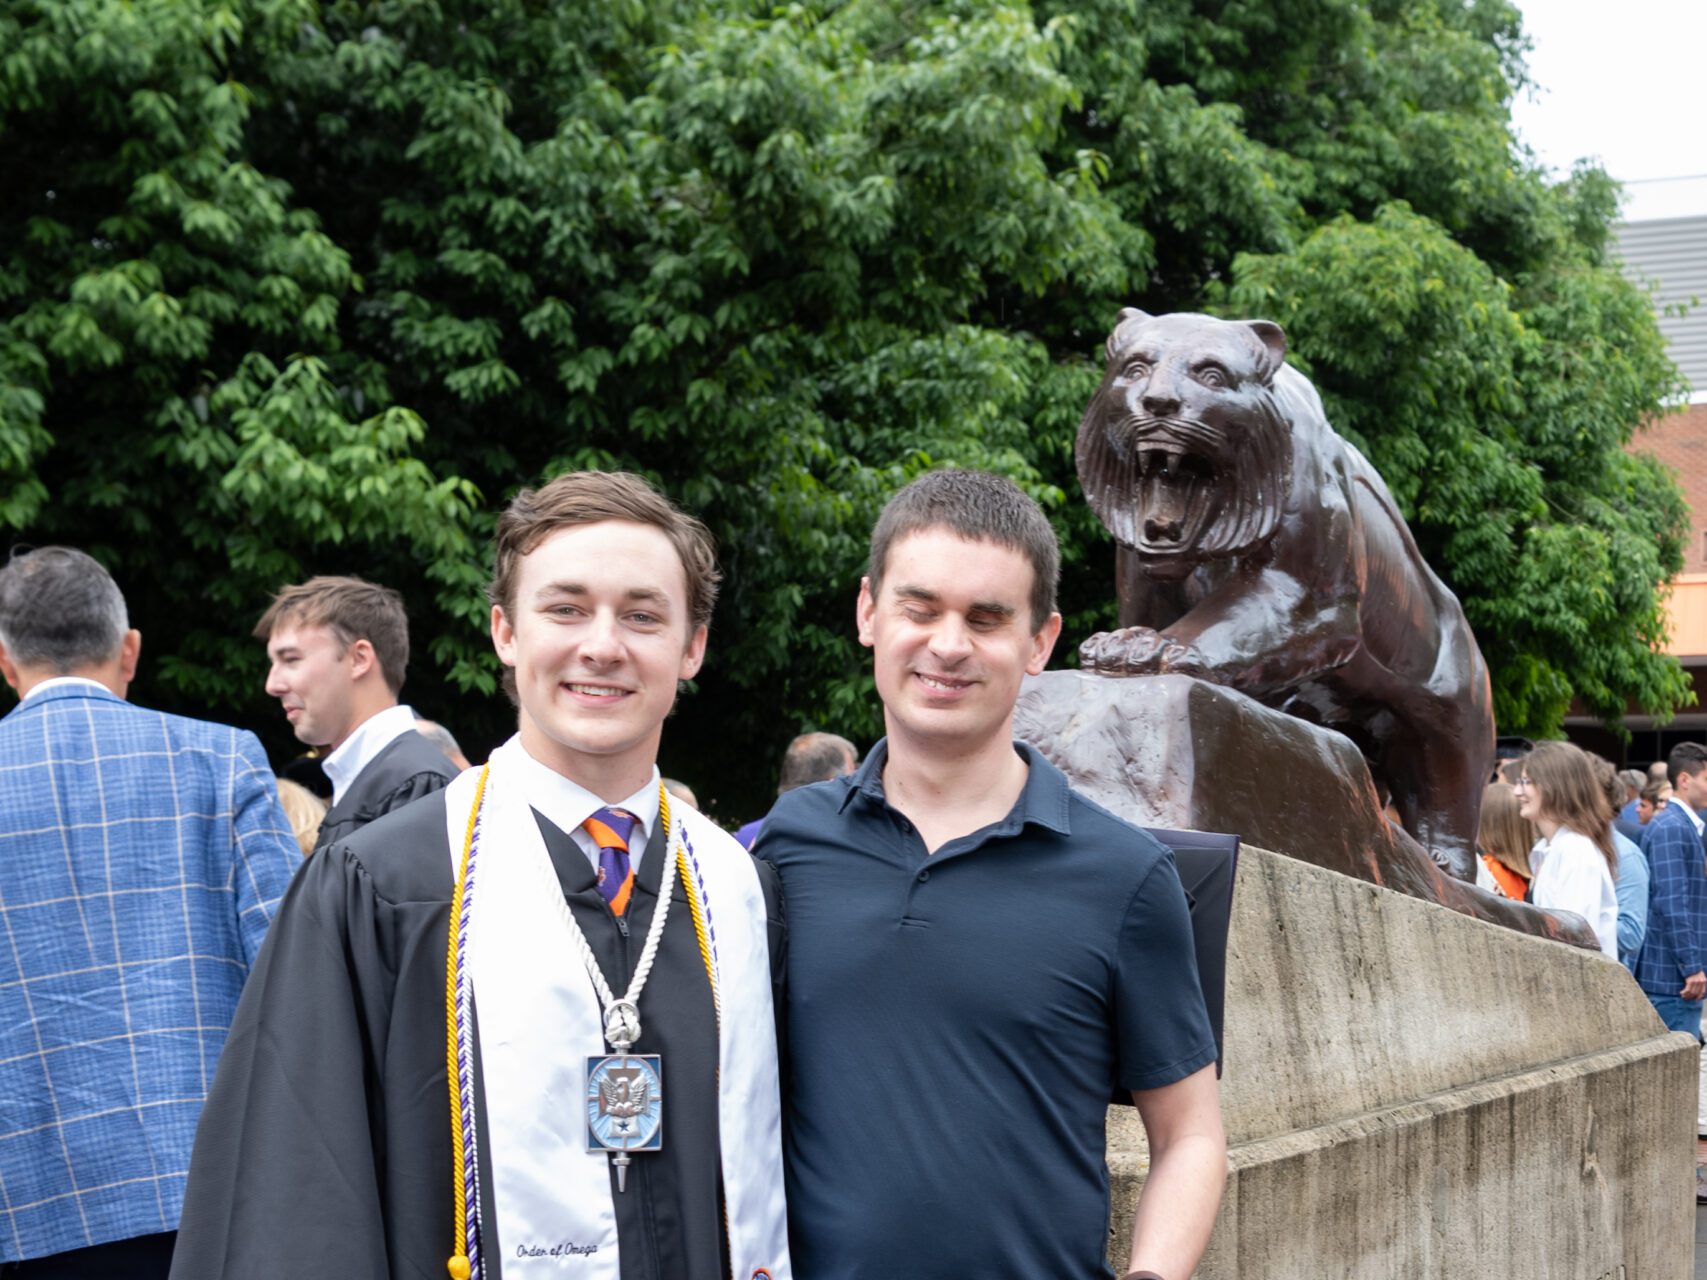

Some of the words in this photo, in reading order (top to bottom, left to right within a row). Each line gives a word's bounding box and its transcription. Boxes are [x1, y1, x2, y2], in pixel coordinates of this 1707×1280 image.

[516, 1244, 547, 1258] Order
[549, 1244, 563, 1259] of
[564, 1242, 598, 1257] Omega
